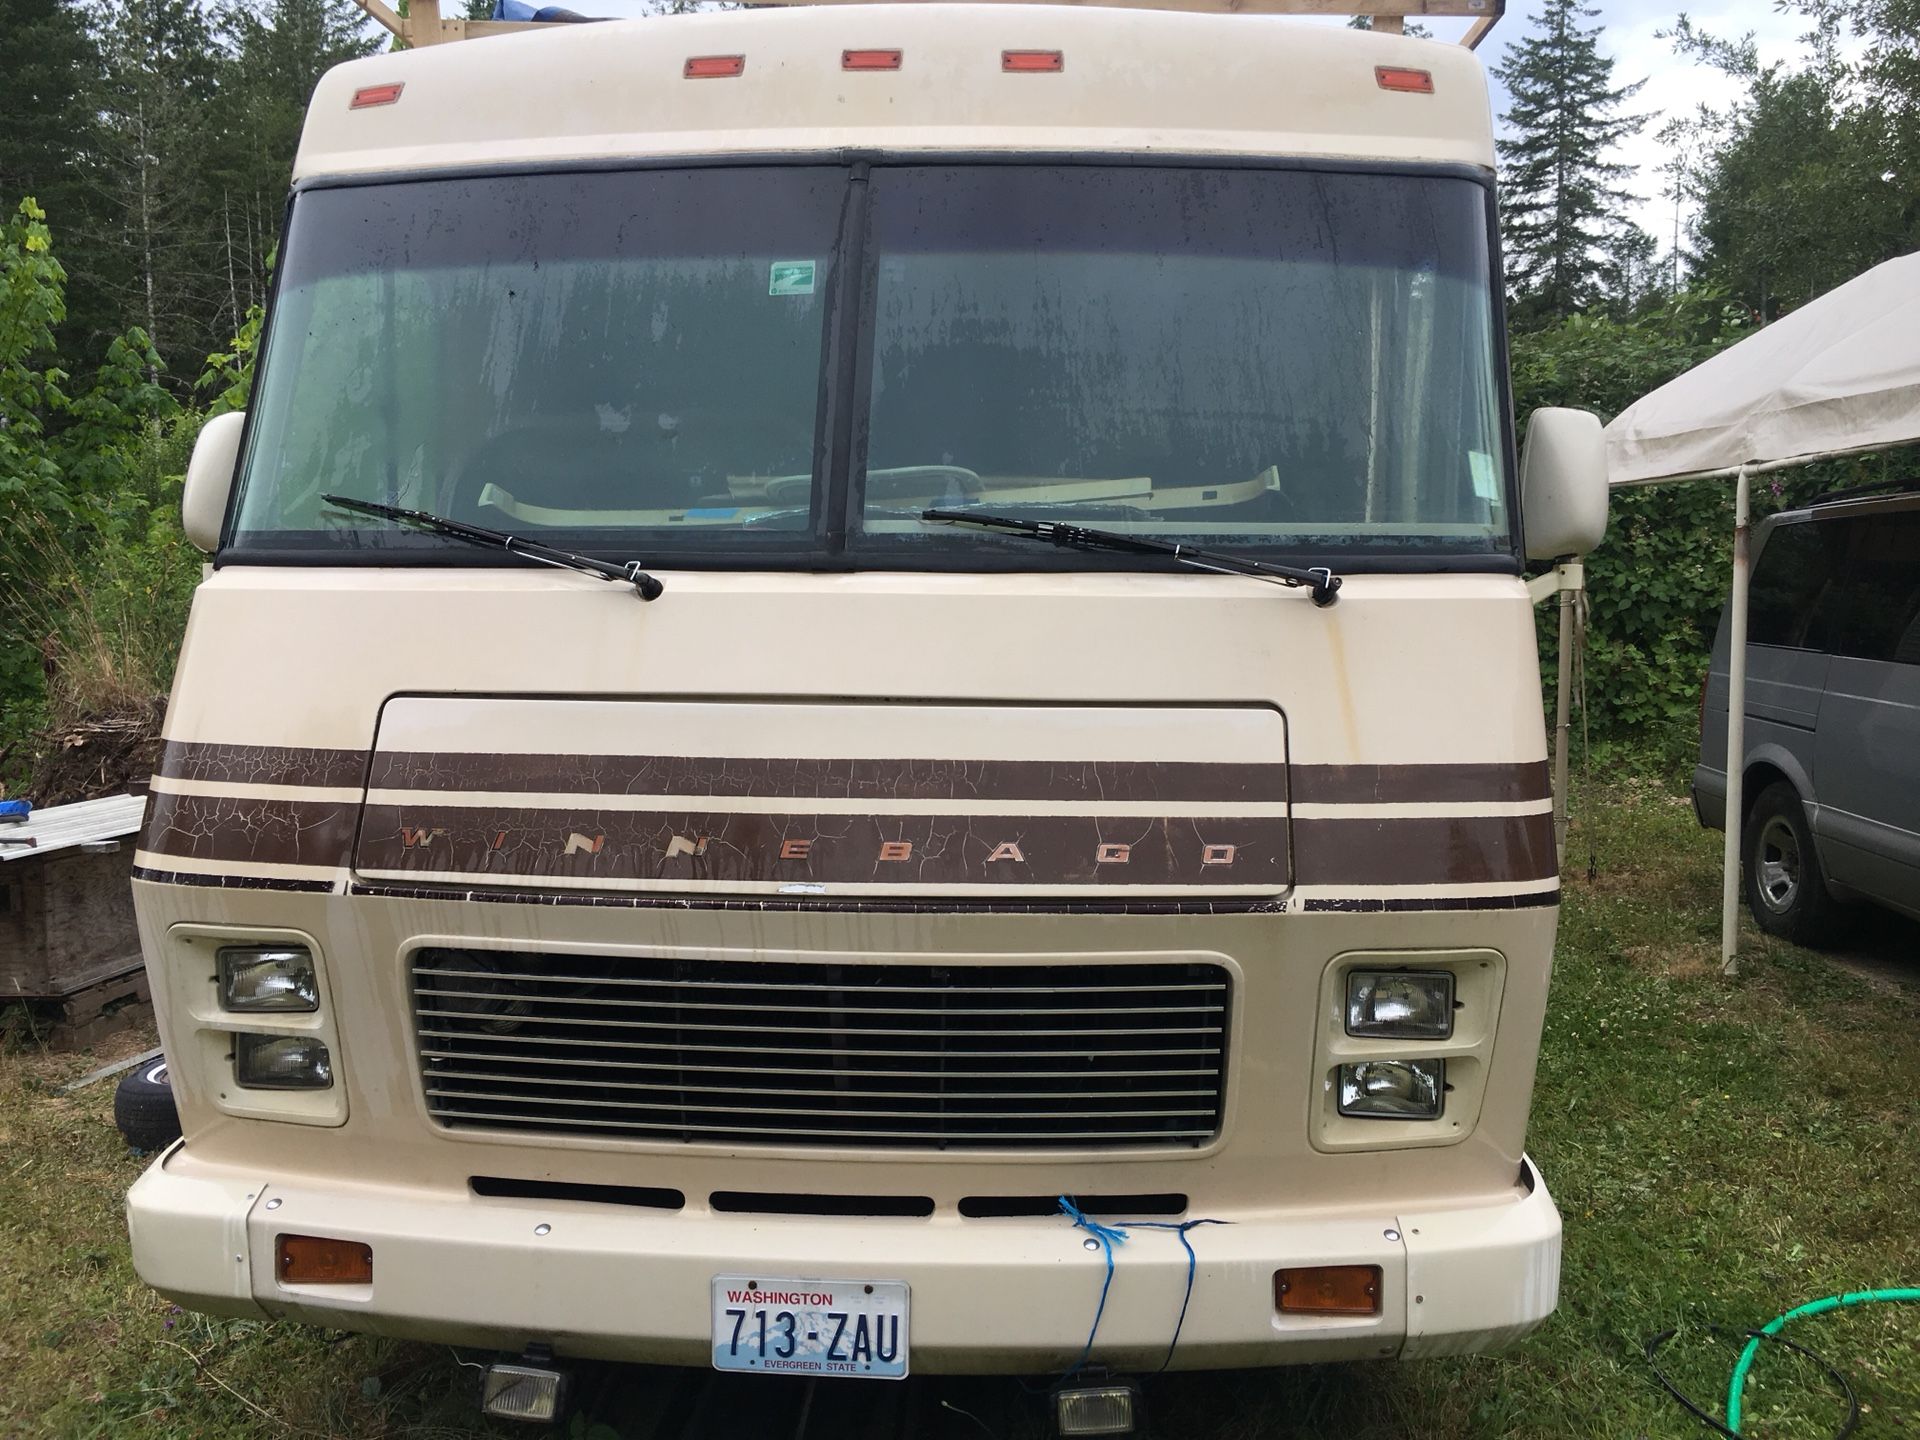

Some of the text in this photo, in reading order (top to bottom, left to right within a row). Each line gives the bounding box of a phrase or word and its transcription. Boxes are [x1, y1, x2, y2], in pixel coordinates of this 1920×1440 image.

[401, 826, 1237, 865] WINNEBAGO
[727, 1290, 833, 1306] WASHINGTON
[764, 1359, 857, 1372] EVERGREEN STATE
